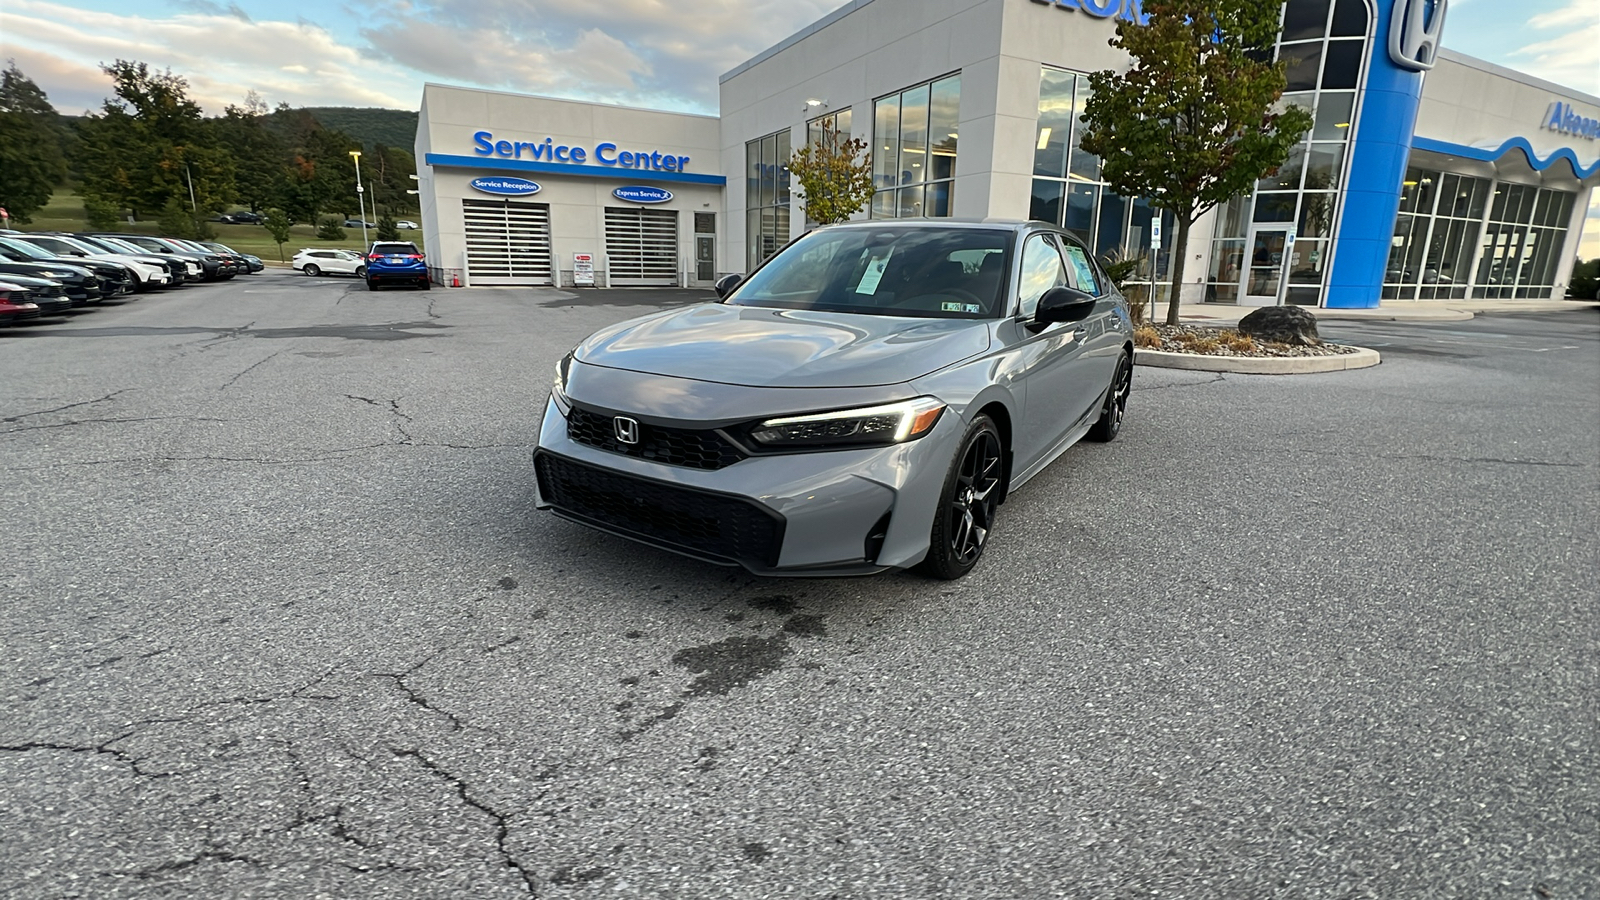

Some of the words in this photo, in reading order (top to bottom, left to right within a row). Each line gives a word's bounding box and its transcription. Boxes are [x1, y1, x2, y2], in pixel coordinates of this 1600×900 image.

[473, 131, 587, 163] Service
[595, 142, 690, 172] Center
[475, 180, 502, 188] Service
[503, 181, 537, 191] Reception
[616, 189, 640, 198] Express
[640, 190, 661, 199] Service
